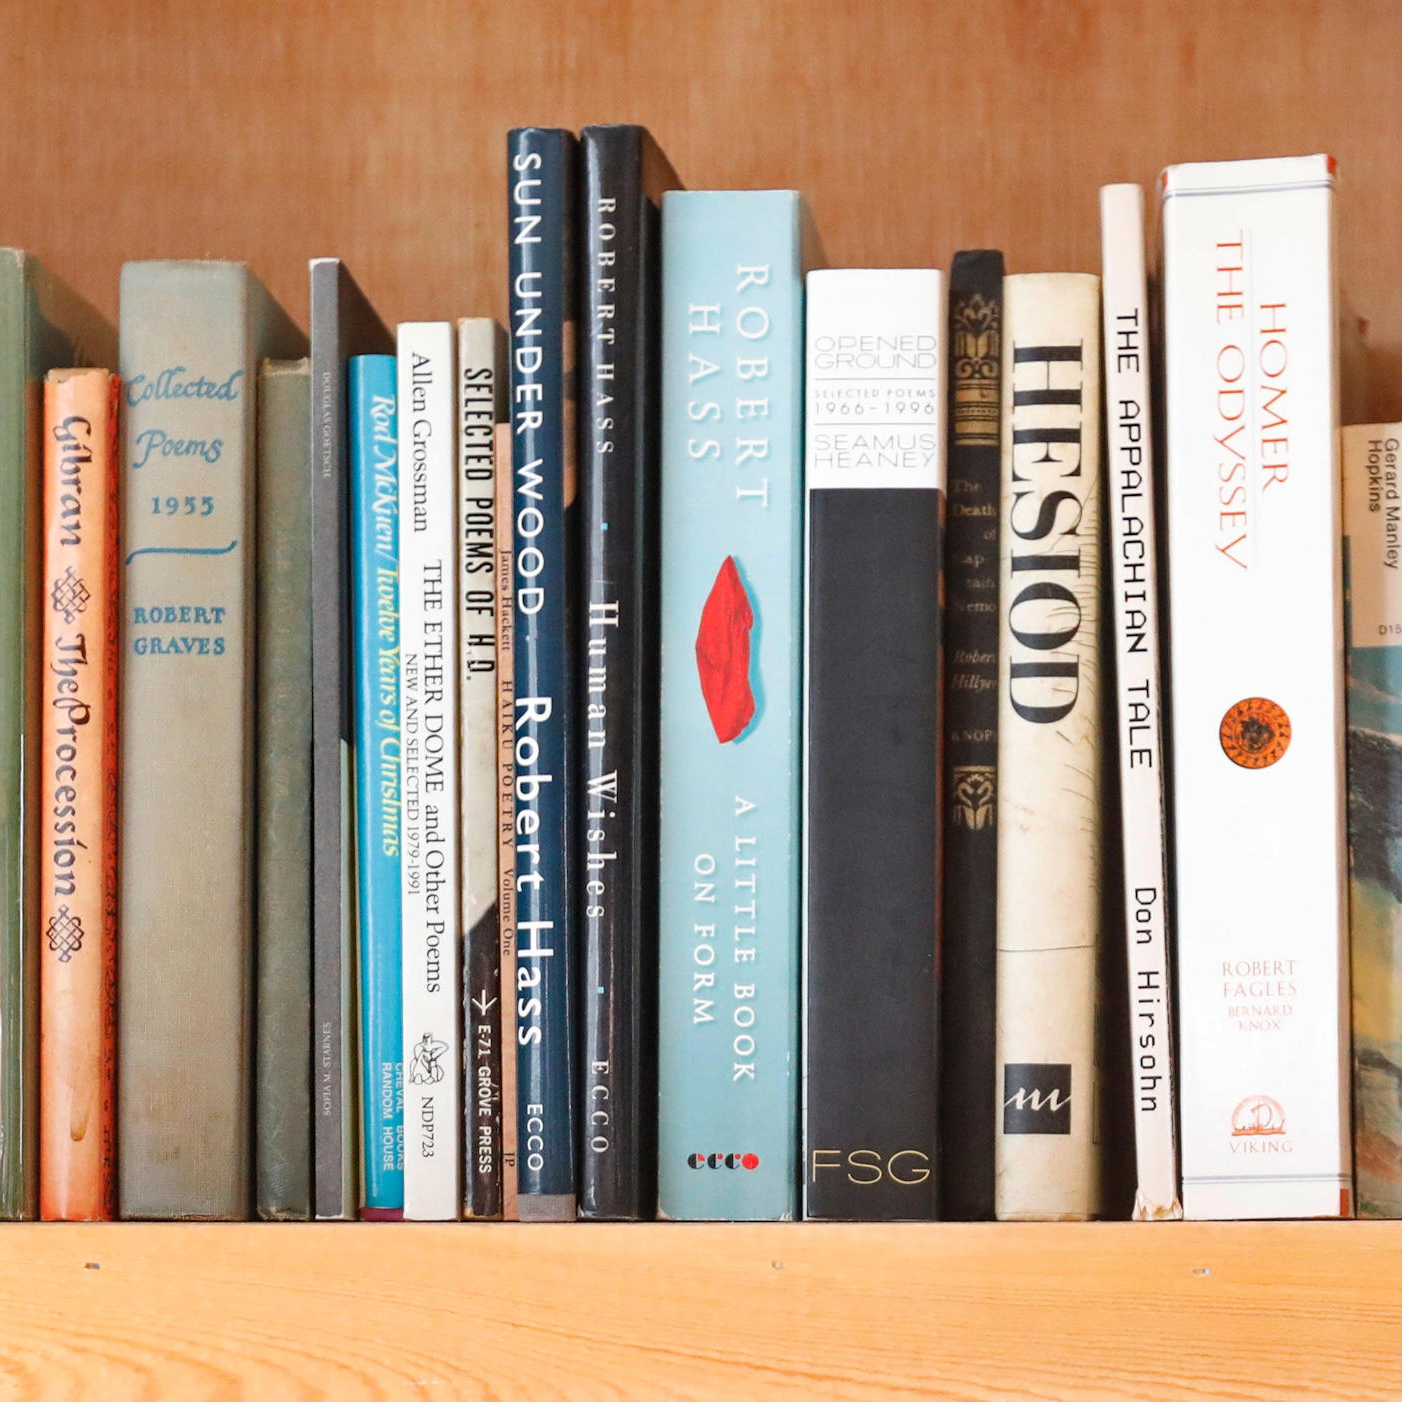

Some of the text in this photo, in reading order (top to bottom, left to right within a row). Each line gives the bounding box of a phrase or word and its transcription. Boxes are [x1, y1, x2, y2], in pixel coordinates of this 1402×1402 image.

[412, 353, 432, 532] Allen Grossman
[512, 153, 545, 615] SUN UNDER WOOD
[1215, 229, 1248, 572] THE ODYSSEY
[1259, 302, 1288, 492] HOMER
[1366, 440, 1382, 512] Hopkins
[1010, 339, 1083, 724] HESIOD
[1117, 308, 1152, 768] THE APPALACHIAN TALE
[1383, 438, 1400, 568] Gerard Manley
[133, 608, 226, 626] ROBERT
[133, 638, 225, 656] GRAVES
[50, 633, 91, 895] The Procession
[516, 698, 553, 1046] Robert Hass
[1135, 888, 1162, 1111] Don Hirsohn
[422, 1097, 434, 1157] NDP723
[525, 1104, 543, 1170] ECCO
[812, 1150, 930, 1184] FSG
